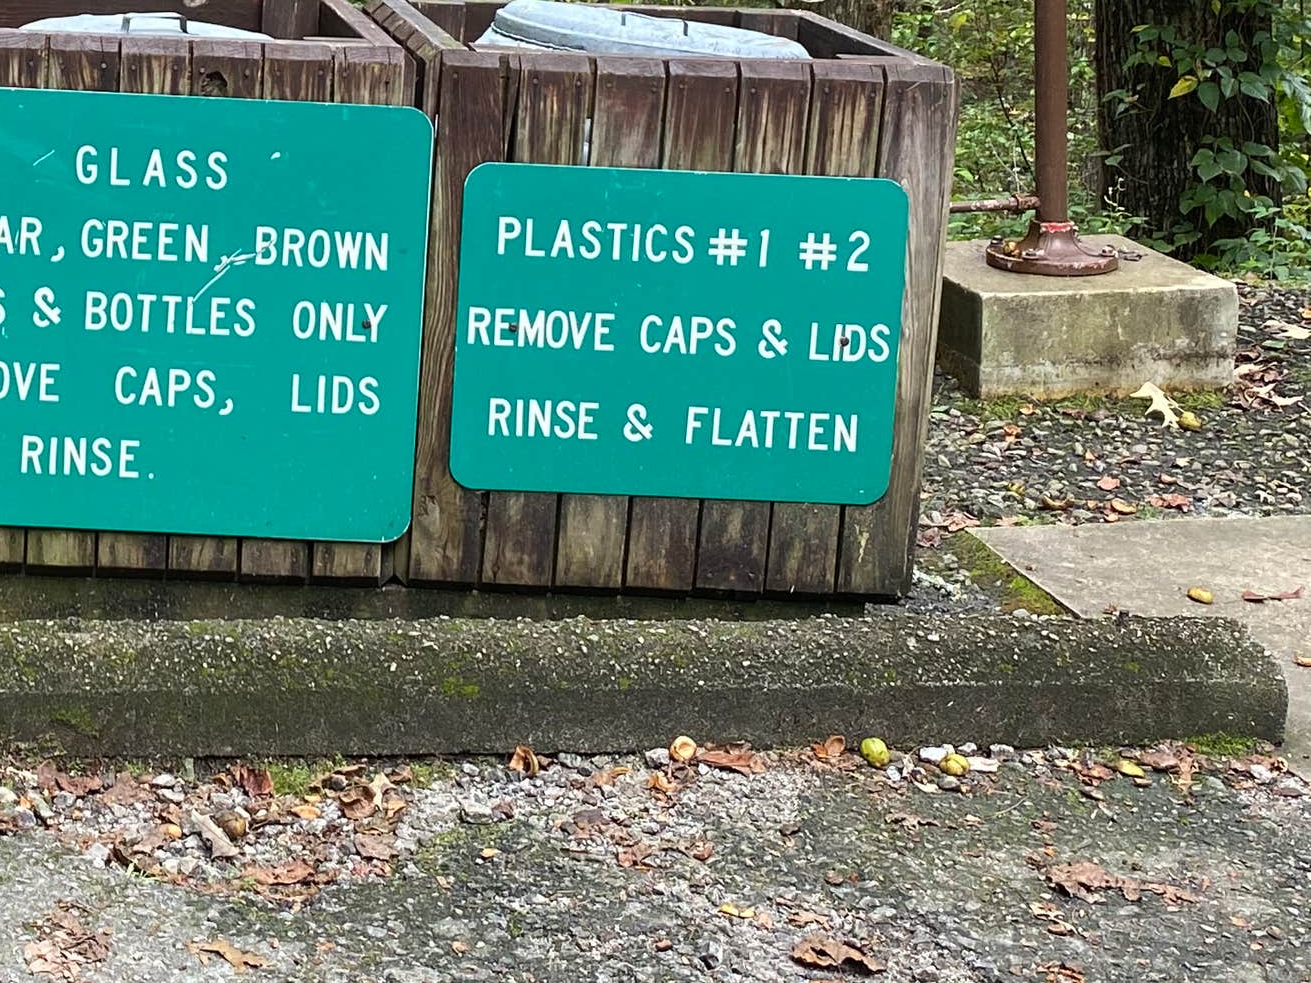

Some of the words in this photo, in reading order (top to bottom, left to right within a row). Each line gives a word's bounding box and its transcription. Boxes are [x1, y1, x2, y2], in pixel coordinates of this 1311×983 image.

[76, 146, 227, 189] GLASS
[254, 226, 389, 271] BROWN
[498, 217, 694, 263] PLASTICS
[709, 229, 769, 267] #1
[800, 231, 869, 271] #2
[33, 287, 60, 327] &
[84, 291, 256, 337] BOTTLES
[293, 301, 387, 342] ONLY
[468, 307, 614, 351] REMOVE
[641, 315, 735, 356] CAPS
[759, 319, 787, 358] &
[809, 323, 890, 362] LIDS
[115, 367, 233, 415] CAPS,
[292, 375, 379, 414] LIDS
[489, 398, 599, 439] RINSE
[624, 404, 652, 441] &
[686, 407, 857, 451] FLATTEN
[21, 435, 153, 478] RINSE.
